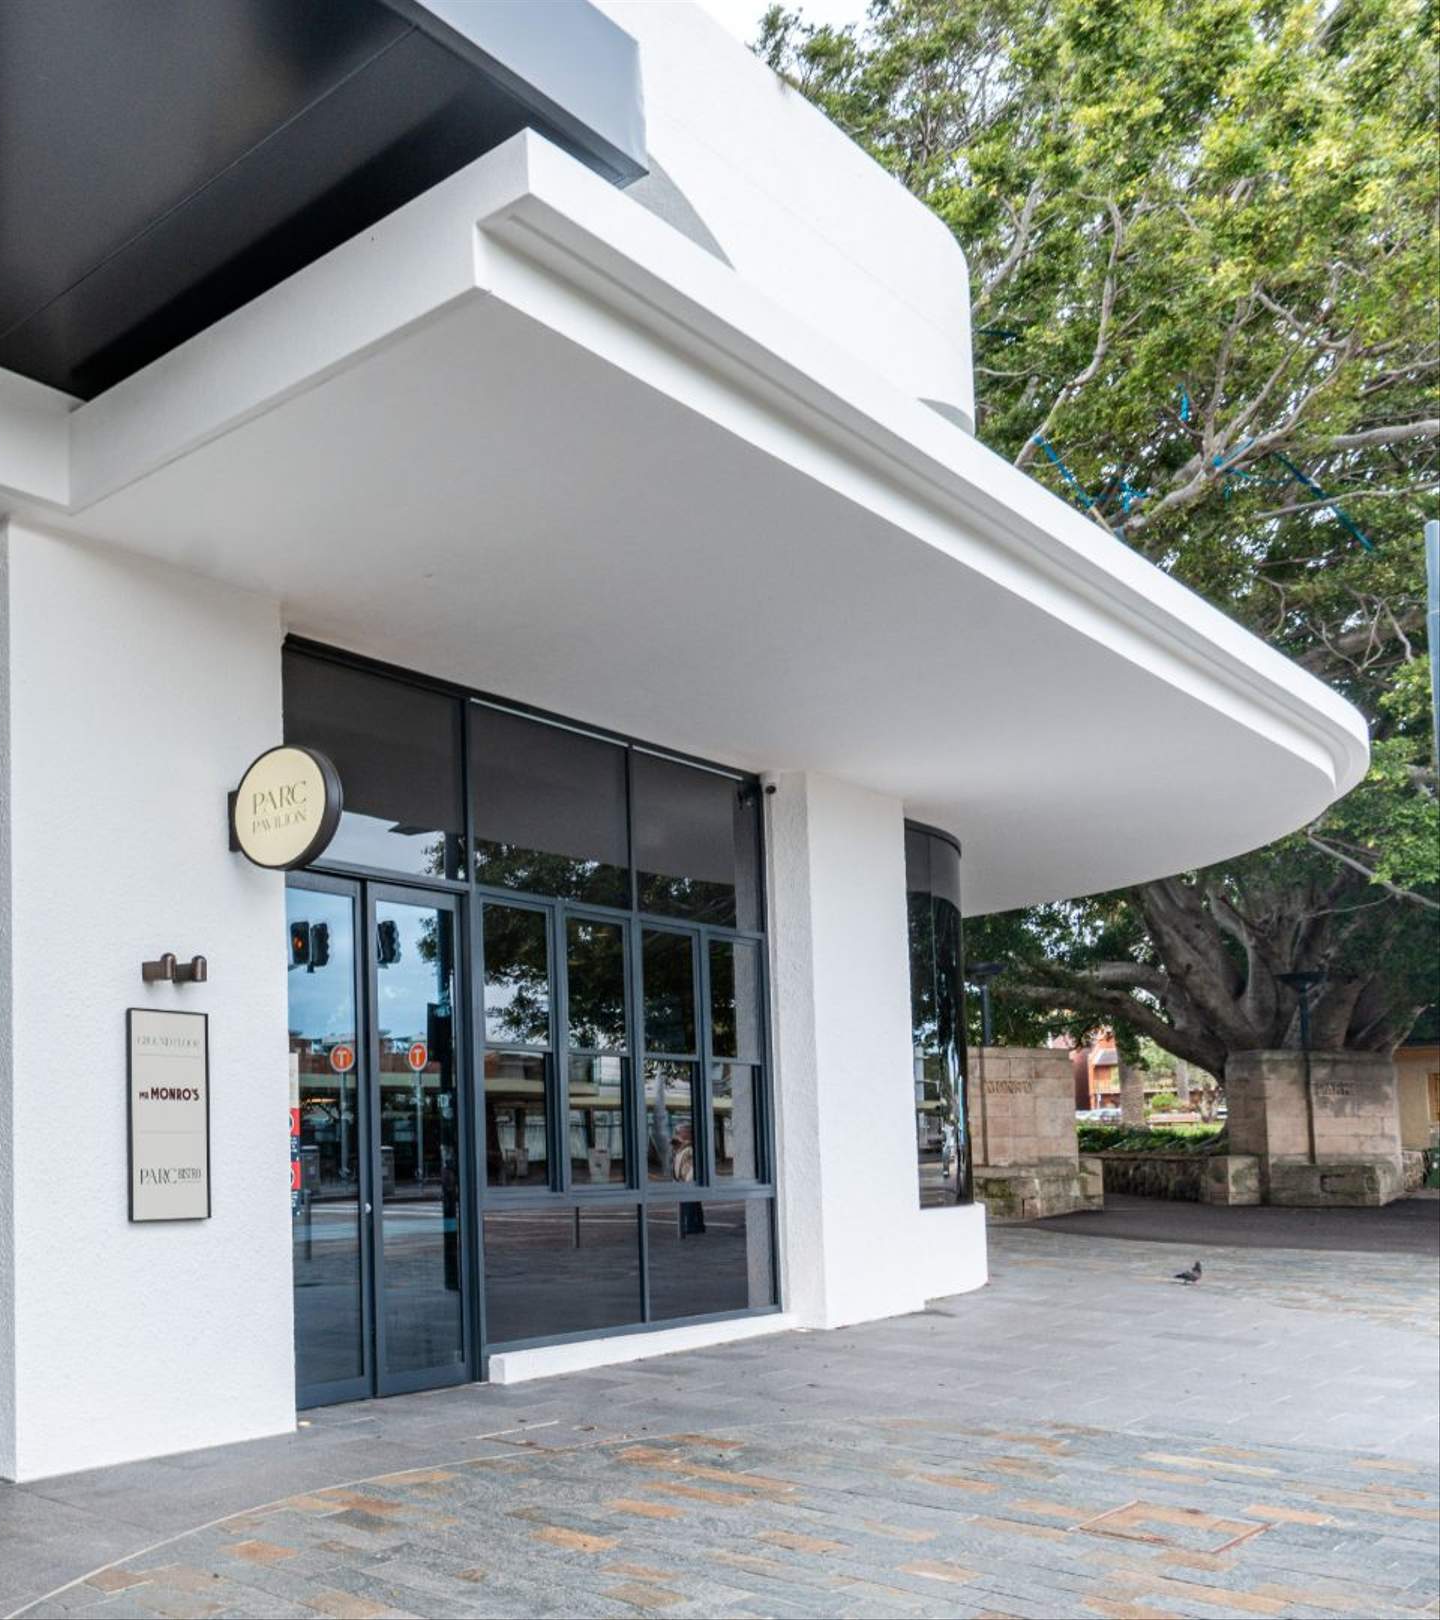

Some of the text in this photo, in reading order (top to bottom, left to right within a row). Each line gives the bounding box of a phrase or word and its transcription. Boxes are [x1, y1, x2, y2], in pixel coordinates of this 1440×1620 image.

[252, 780, 307, 815] PARC
[252, 811, 307, 835] PAVILION
[151, 1087, 200, 1101] MONRO'S
[140, 1167, 201, 1185] PARC BISTRO
